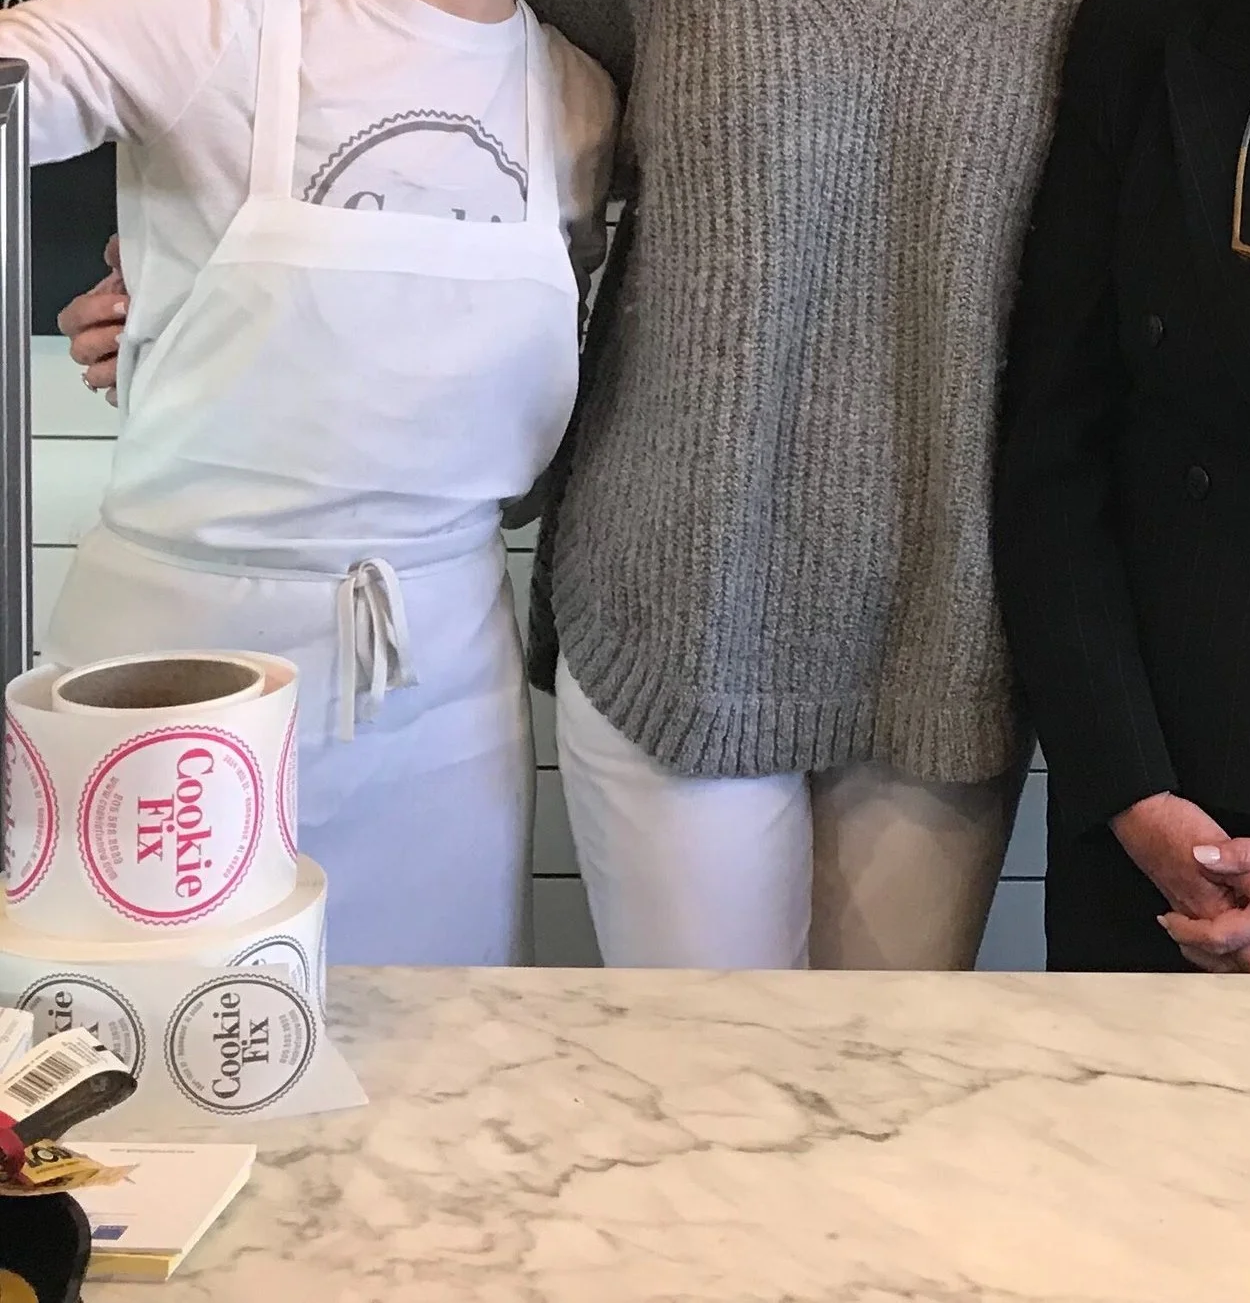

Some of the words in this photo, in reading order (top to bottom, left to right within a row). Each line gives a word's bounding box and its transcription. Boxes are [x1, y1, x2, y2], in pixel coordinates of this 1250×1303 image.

[137, 793, 176, 865] Fix
[175, 747, 216, 899] Cookie
[212, 991, 242, 1099] Cookie
[242, 1016, 270, 1065] Fix
